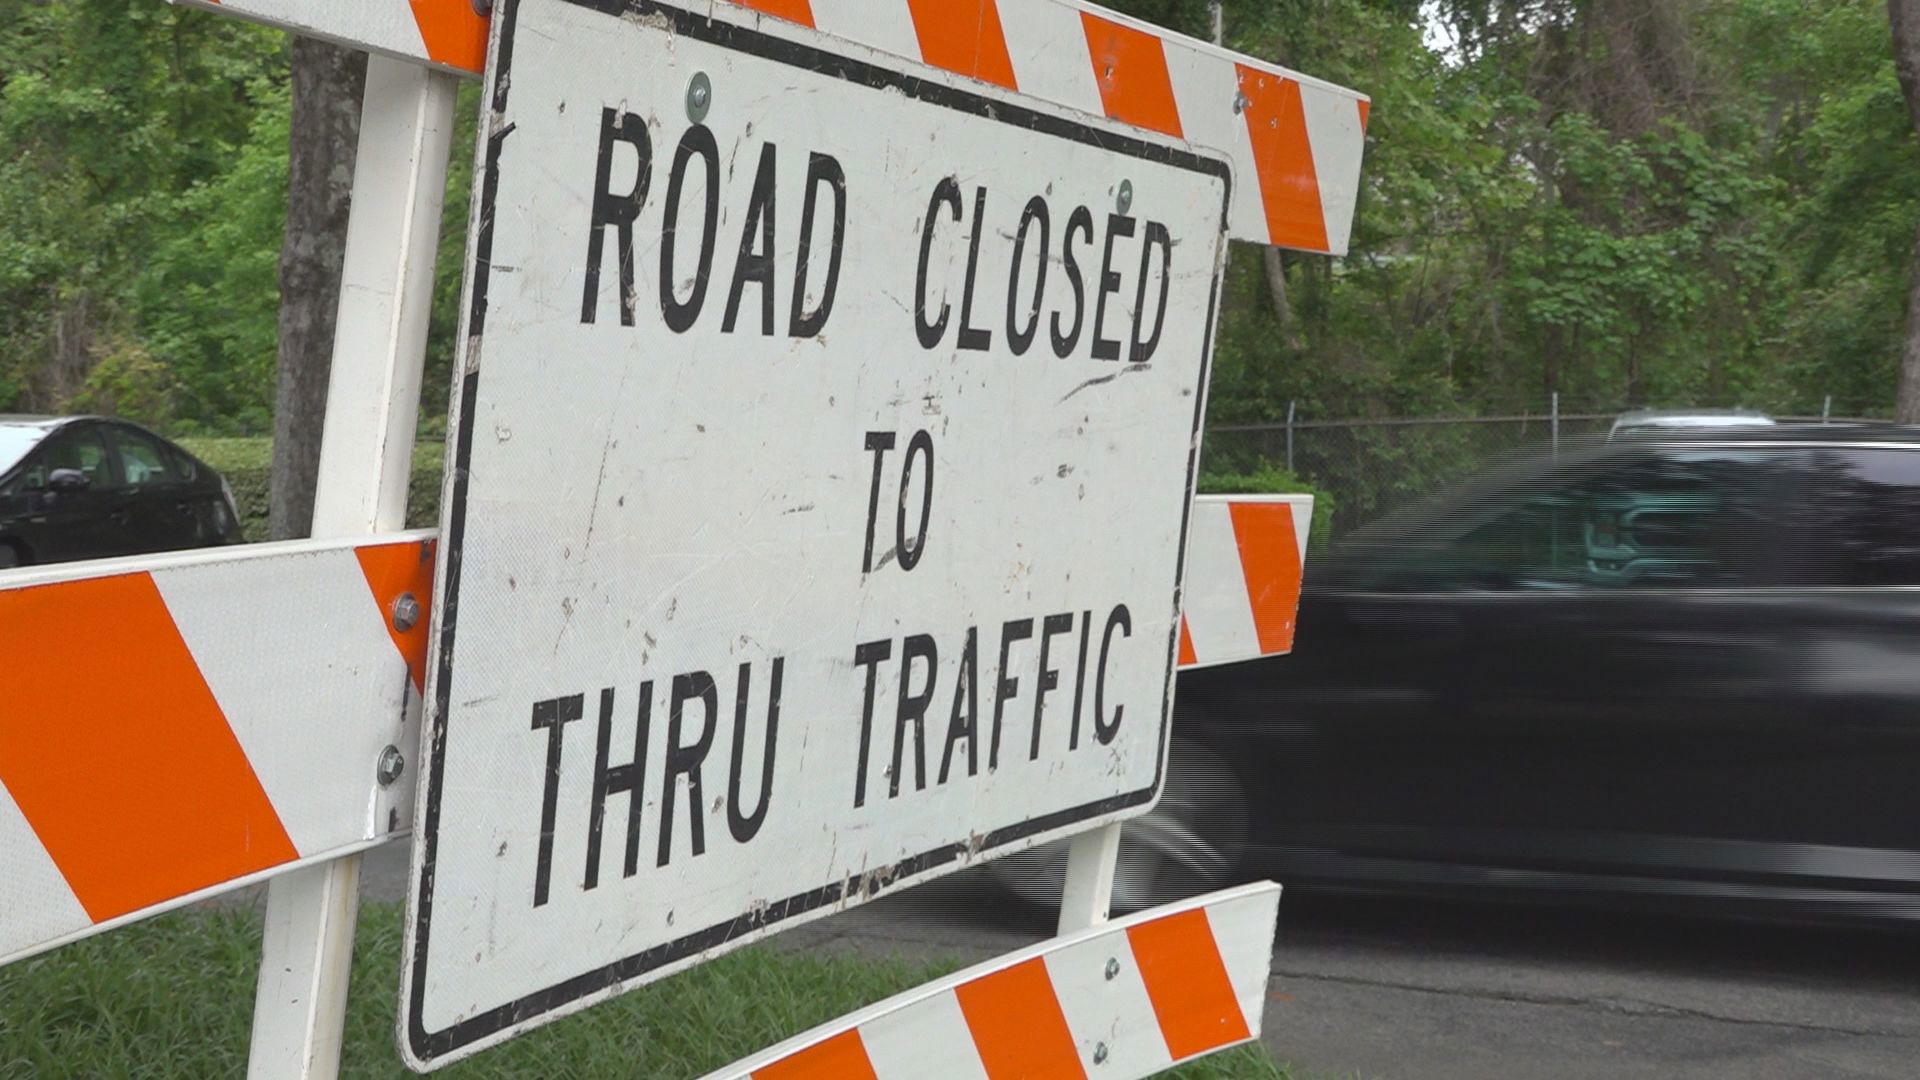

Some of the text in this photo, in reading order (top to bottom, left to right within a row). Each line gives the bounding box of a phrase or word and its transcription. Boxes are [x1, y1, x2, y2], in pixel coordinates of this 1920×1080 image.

[581, 107, 1172, 362] ROAD CLOSED
[862, 429, 934, 573] TO
[531, 603, 1132, 908] THRU TRAFFIC
